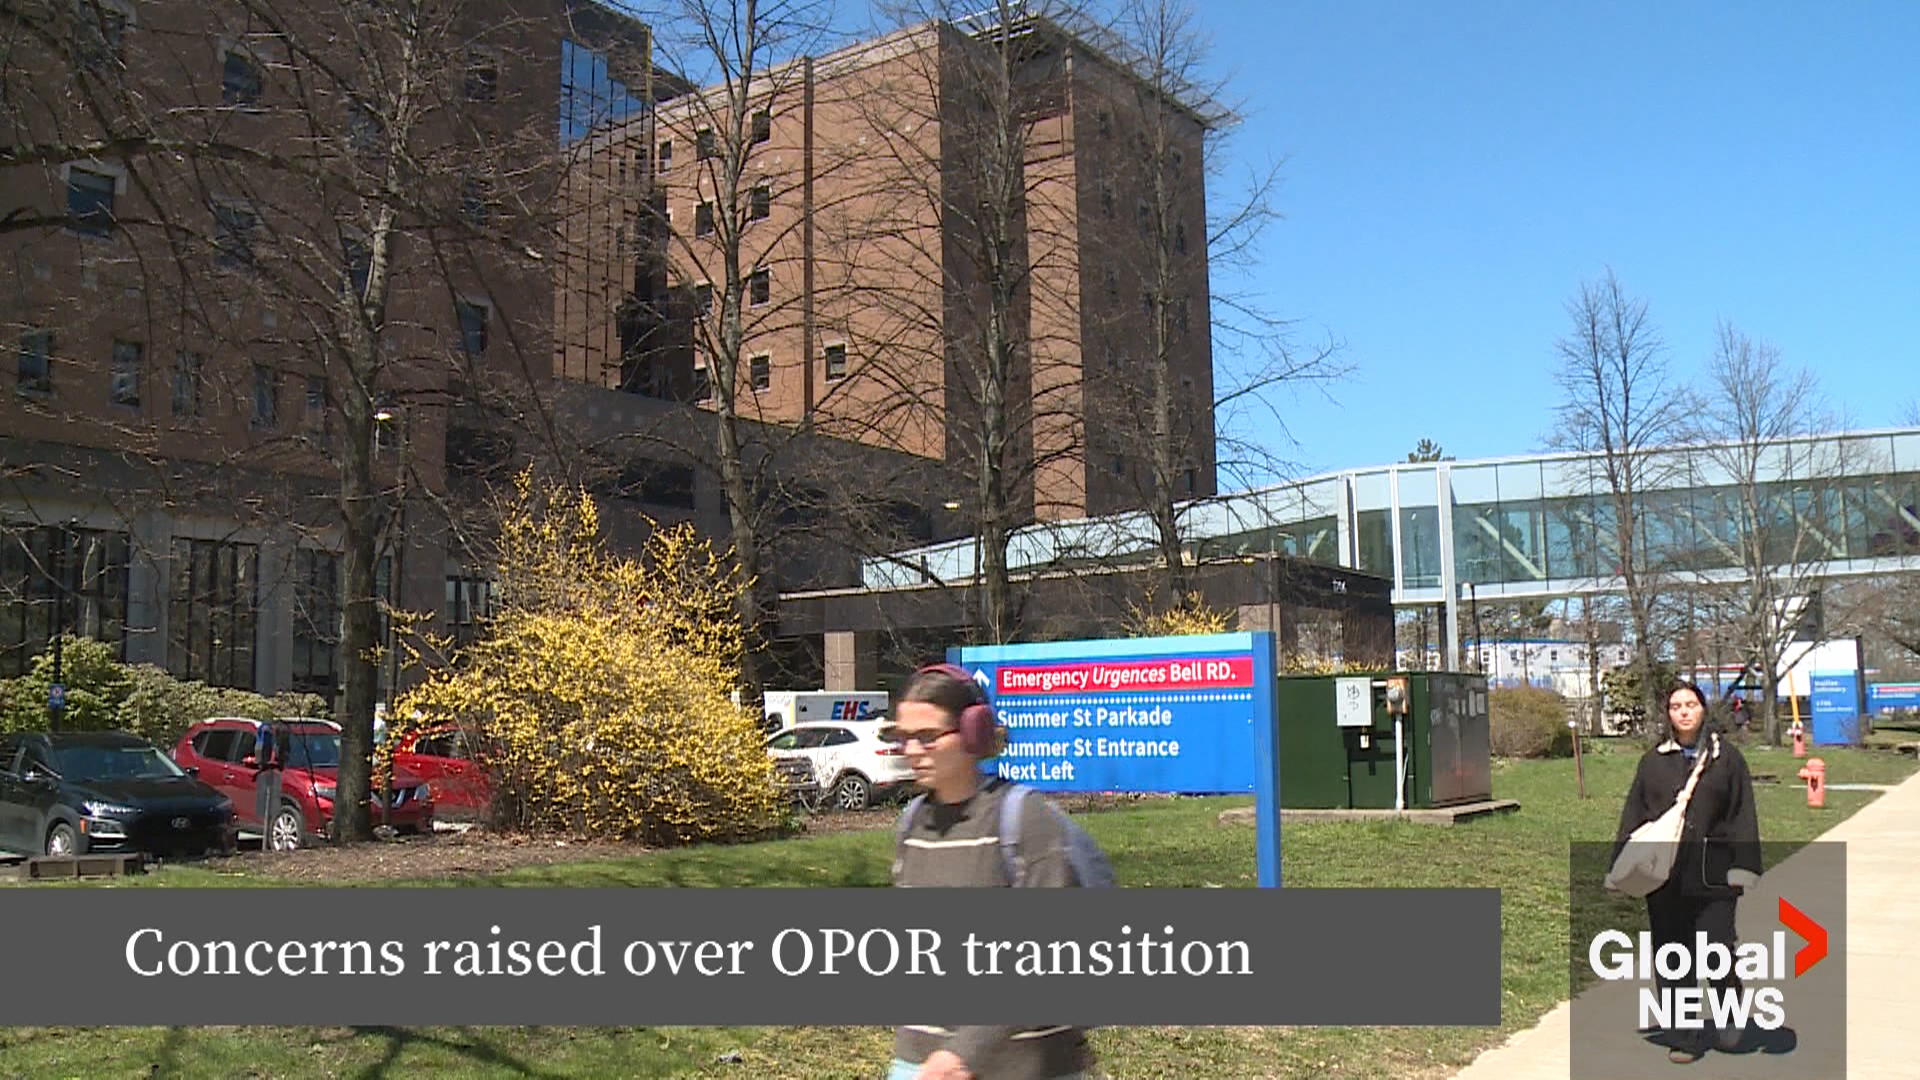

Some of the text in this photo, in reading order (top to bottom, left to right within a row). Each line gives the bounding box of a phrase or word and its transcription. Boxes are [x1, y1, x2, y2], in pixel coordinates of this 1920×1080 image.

[1003, 661, 1236, 690] Emergency Urgences Bell RD.
[831, 701, 870, 720] EHS
[998, 705, 1172, 728] Summer St Parkade
[1074, 738, 1092, 757] St
[1097, 737, 1180, 756] Entrance
[998, 760, 1075, 780] Next Left
